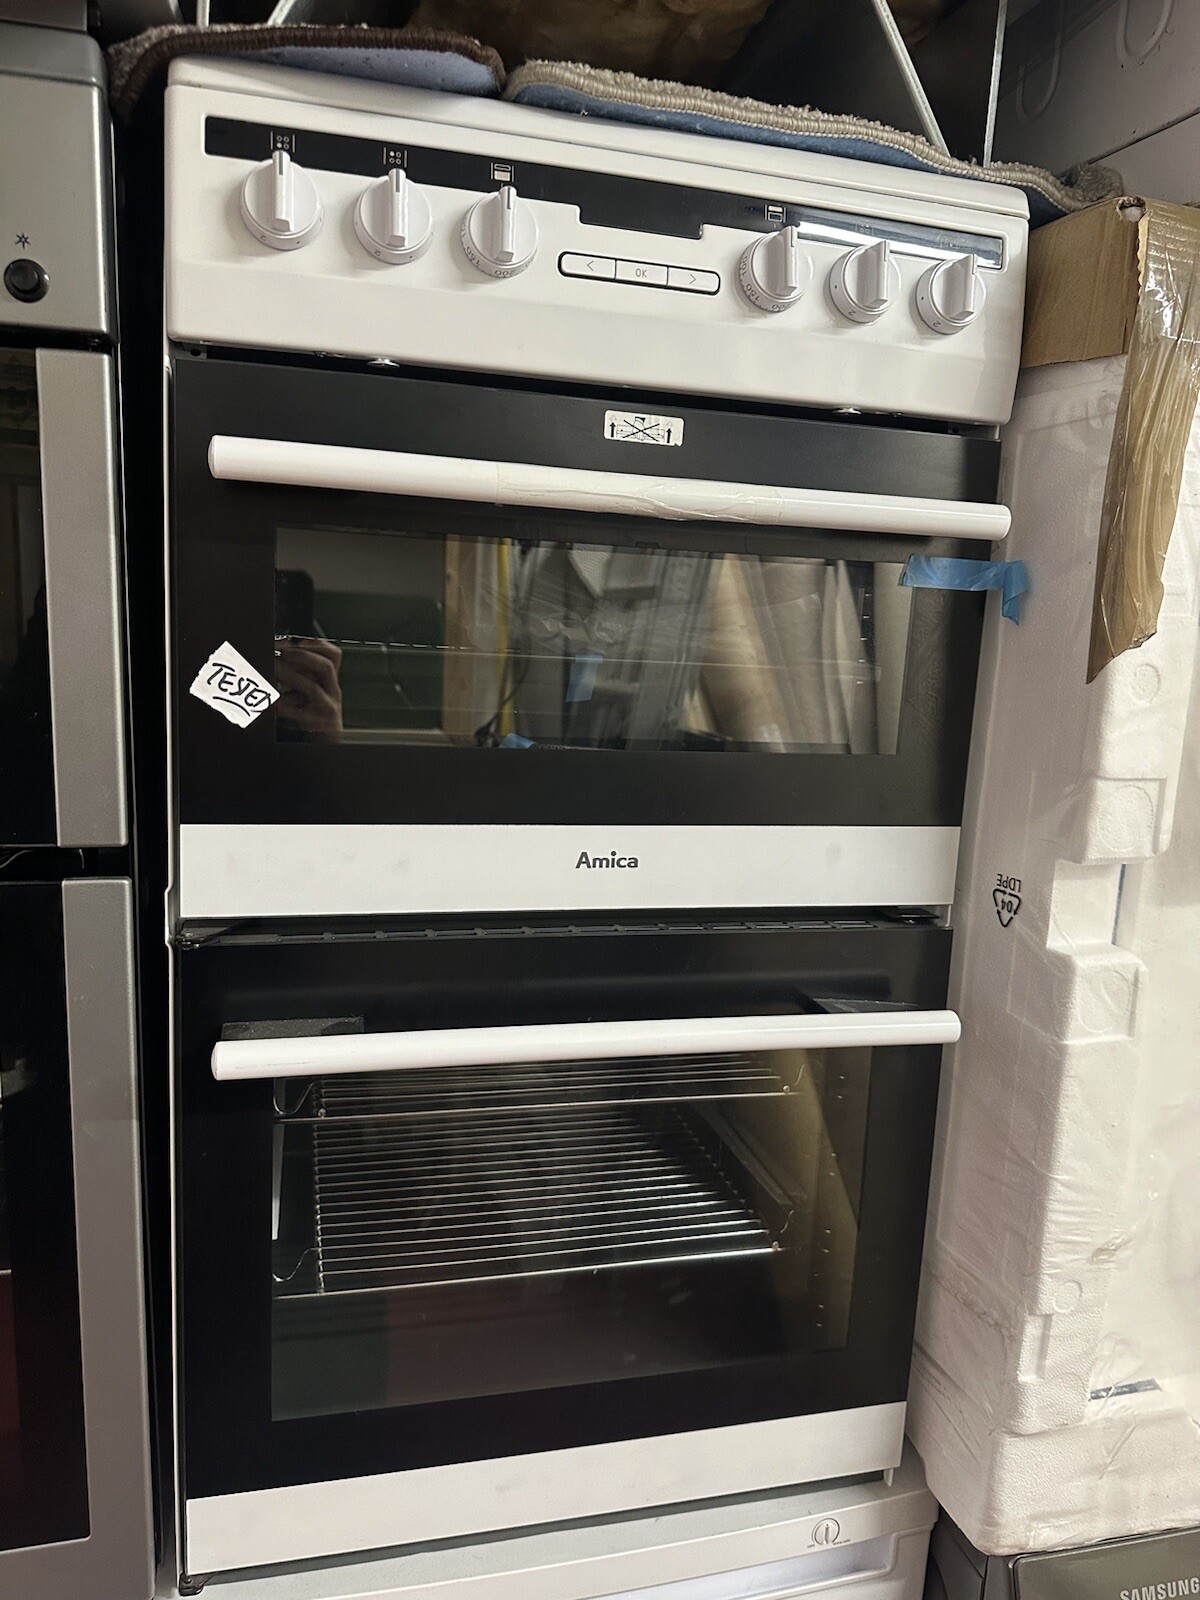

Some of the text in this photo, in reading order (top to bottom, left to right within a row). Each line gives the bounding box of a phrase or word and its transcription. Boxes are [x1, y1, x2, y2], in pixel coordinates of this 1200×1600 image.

[635, 268, 648, 279] OK
[746, 283, 760, 301] 150
[206, 662, 272, 713] TESTED
[575, 850, 639, 869] Amica
[996, 873, 1022, 893] LDPE
[1000, 898, 1013, 913] 04
[1119, 1577, 1200, 1600] SAMSUNG
